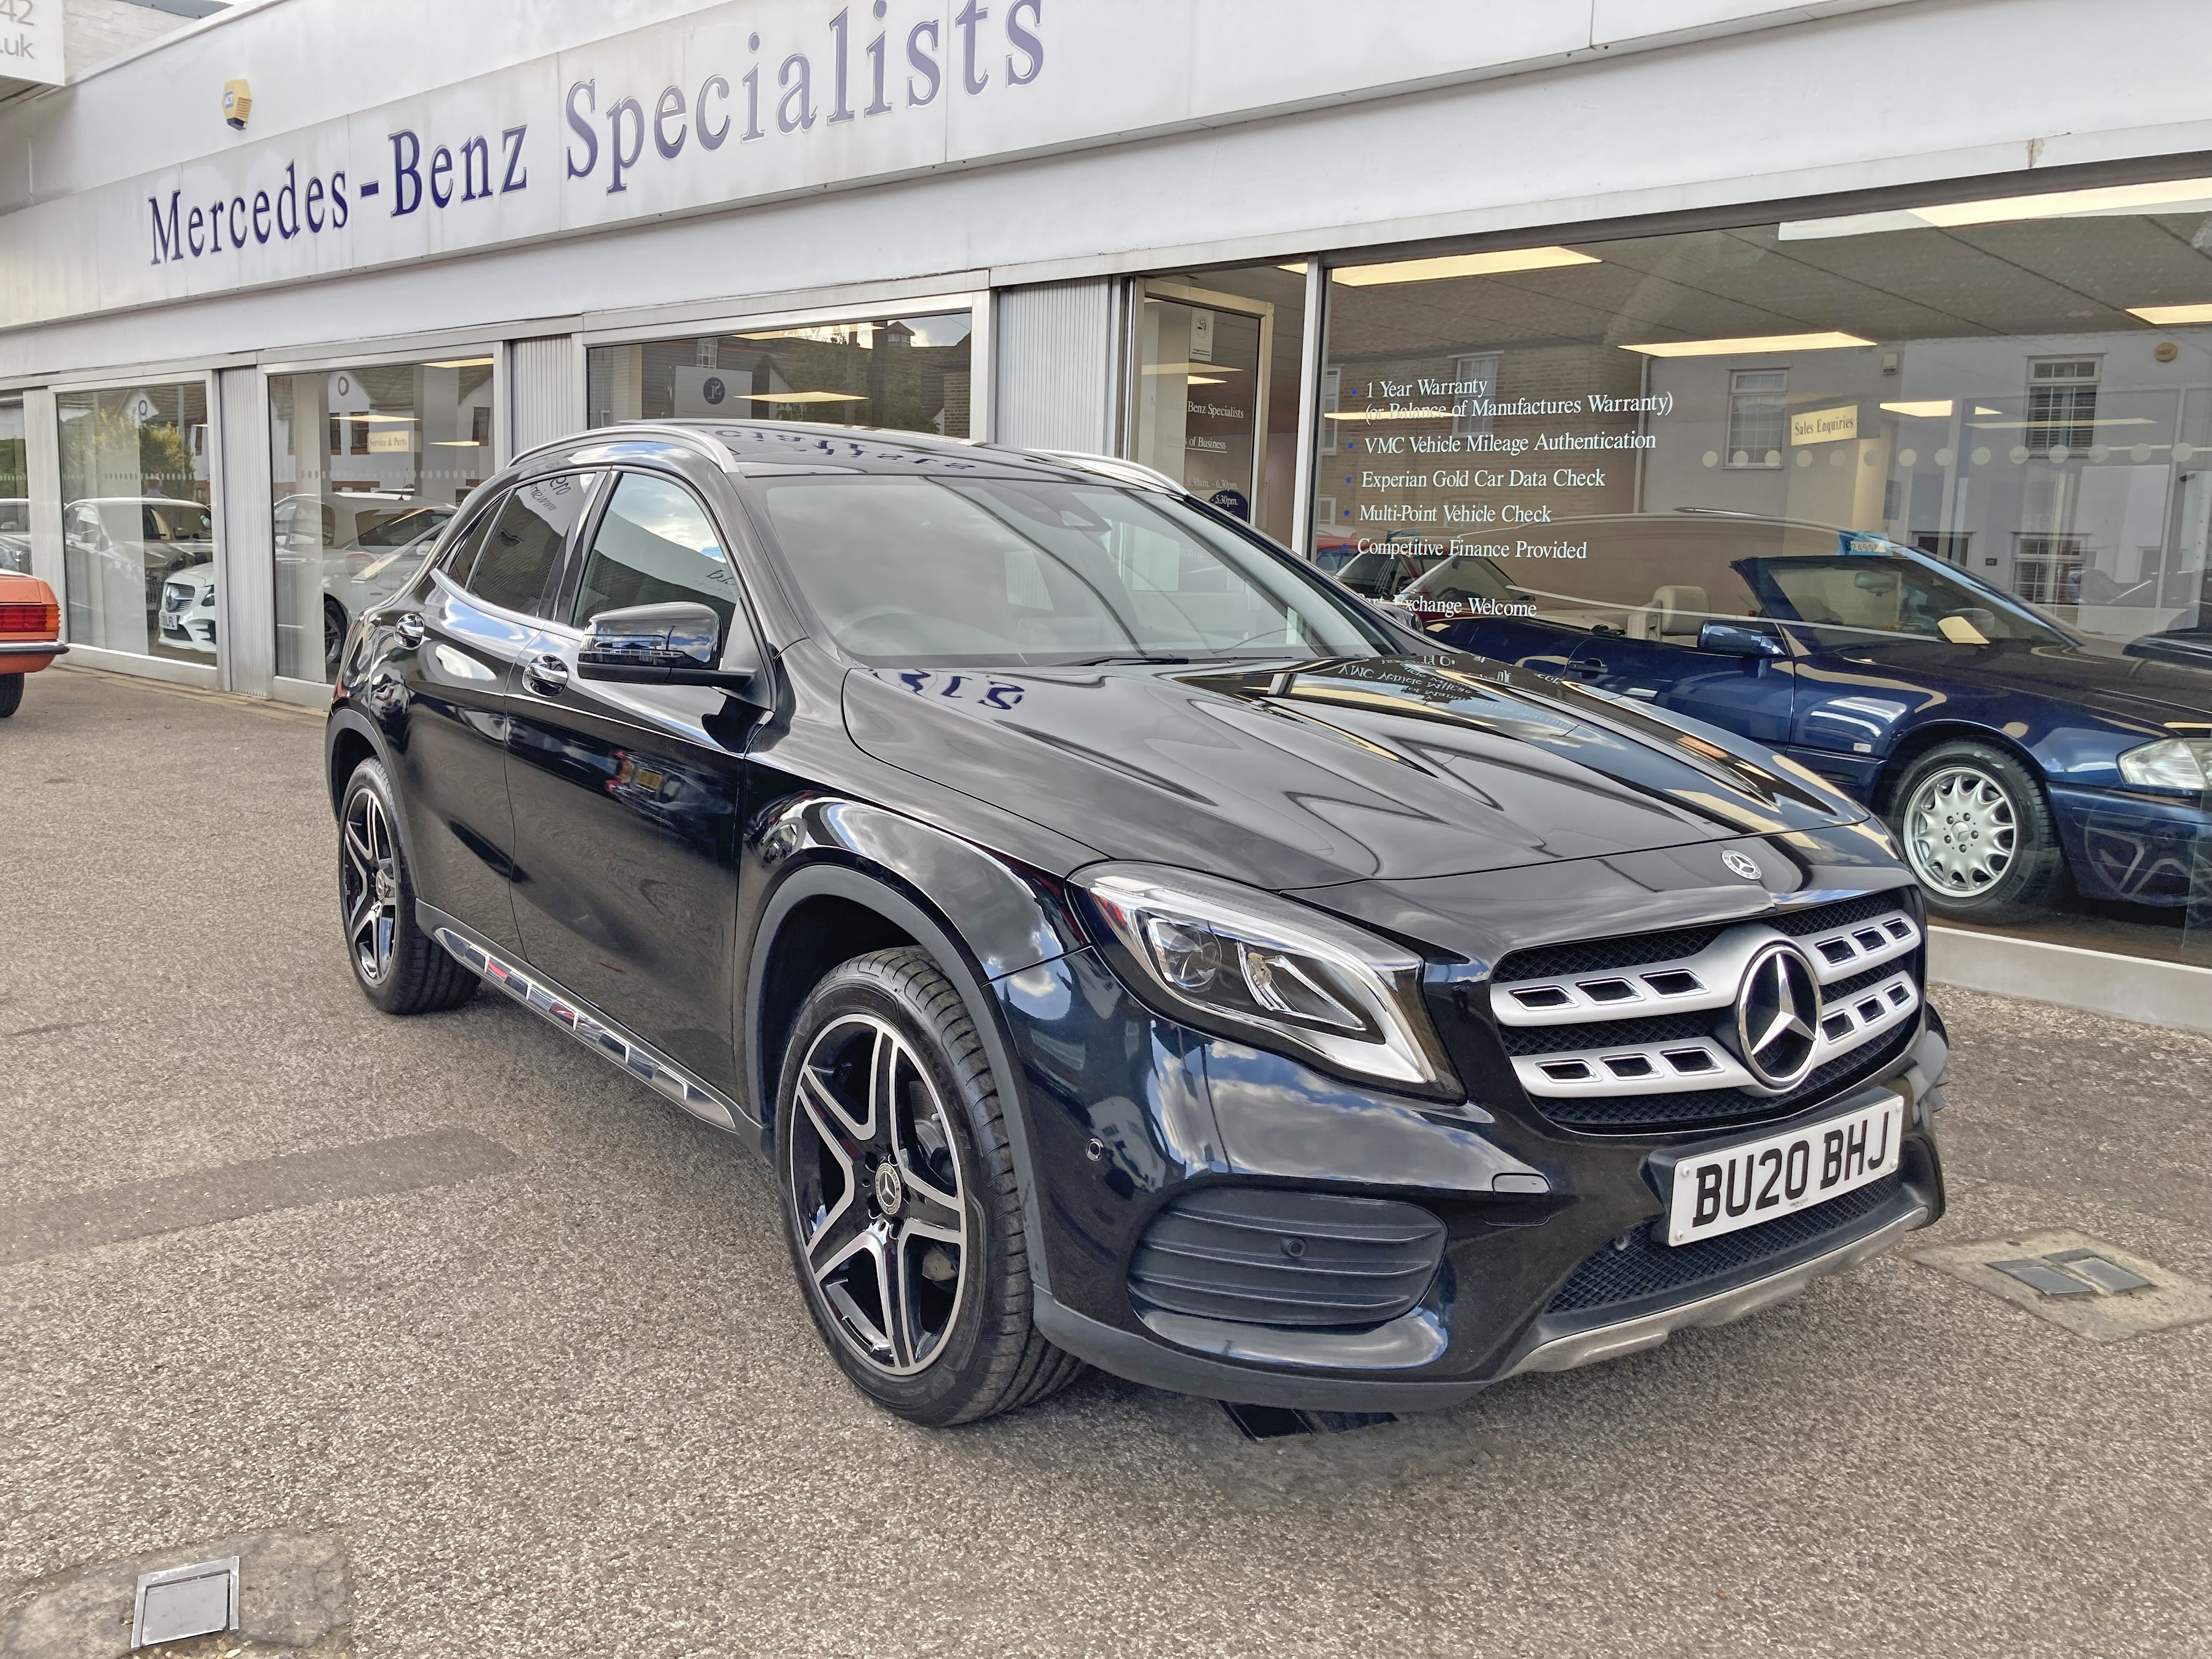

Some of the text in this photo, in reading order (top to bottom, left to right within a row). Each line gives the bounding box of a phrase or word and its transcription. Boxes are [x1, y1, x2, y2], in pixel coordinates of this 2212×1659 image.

[148, 0, 1045, 266] Mercedes-Benz Specialists
[1366, 378, 1488, 398] 1 Year Warranty
[1207, 403, 1244, 419] Specialists
[1365, 391, 1673, 426] (or Balance of Manufactures Warranty)
[1795, 415, 1854, 436] Sales Enquiries
[369, 438, 387, 447] Service
[393, 437, 407, 446] Parts
[1189, 436, 1197, 447] of
[1198, 436, 1227, 450] Business
[1364, 430, 1657, 456] VMC Vehicle Mileage Authentication
[1361, 468, 1606, 493] Experian Gold Car Data Check
[1359, 504, 1553, 523] Multi-Point Vehicle Check
[1357, 538, 1588, 560] Competitive Finance Provided
[1468, 597, 1537, 617] Welcome
[1692, 1111, 1889, 1228] BU20 BHJ
